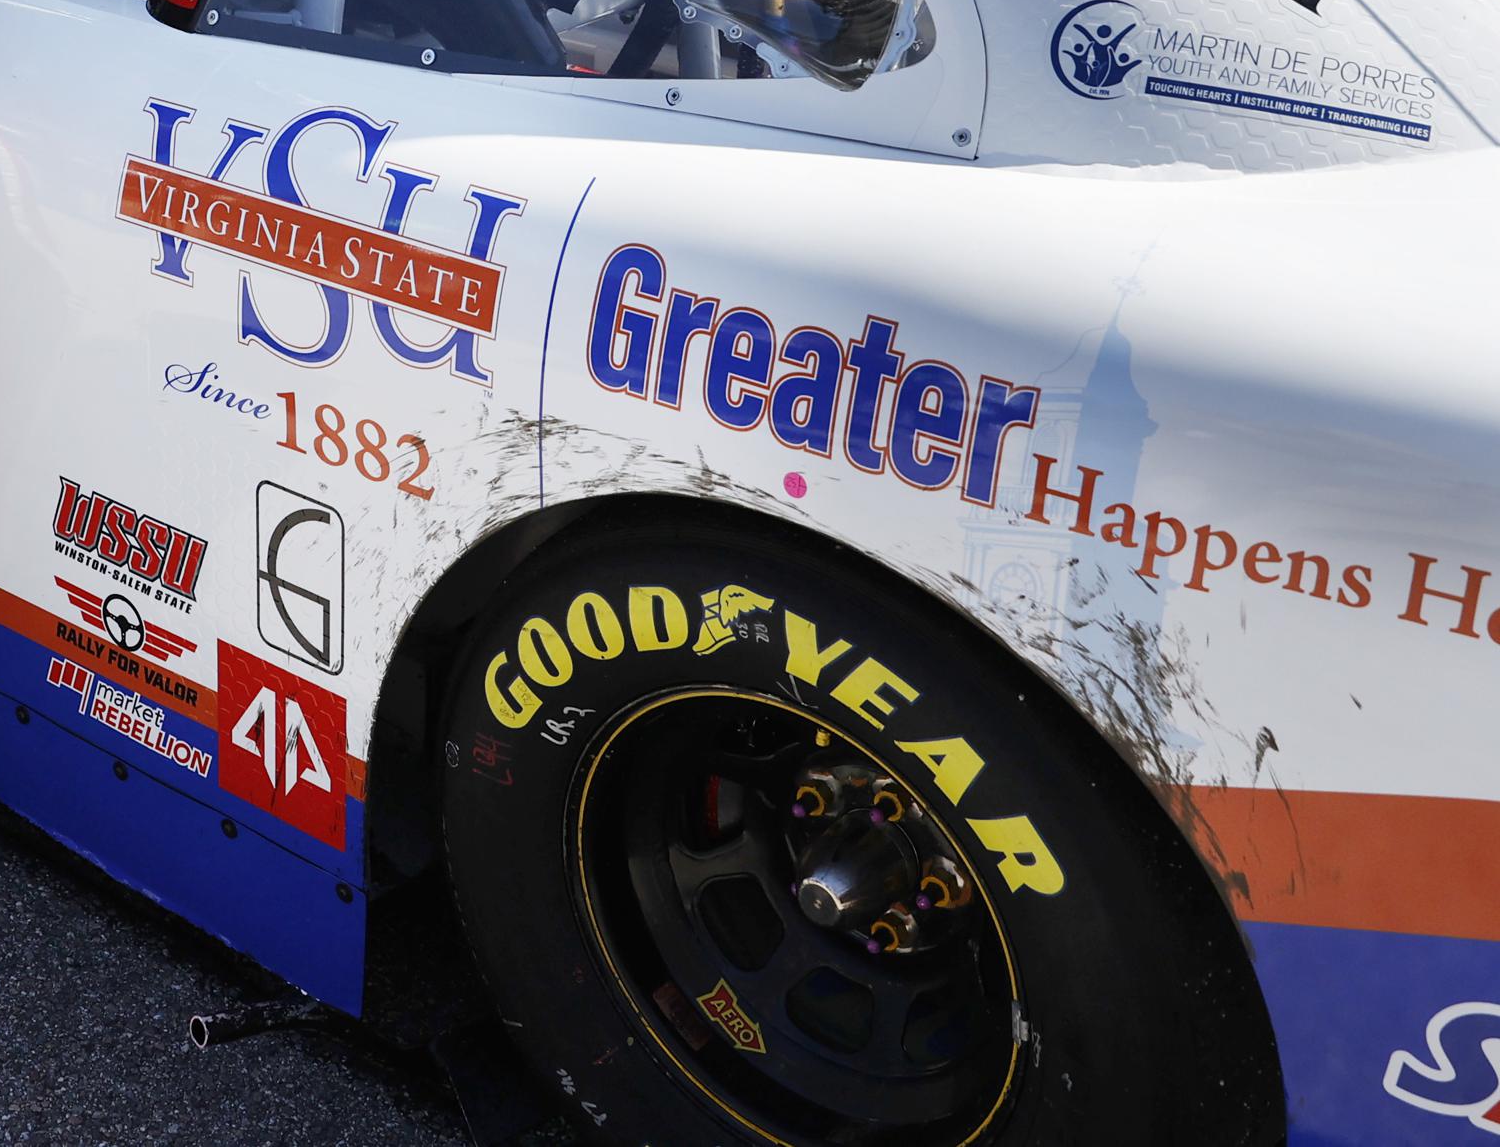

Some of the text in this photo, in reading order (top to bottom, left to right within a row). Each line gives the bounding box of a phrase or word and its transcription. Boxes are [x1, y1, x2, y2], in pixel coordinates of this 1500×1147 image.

[1148, 54, 1433, 119] YOUTH AND FAMILY SERVICES
[1152, 27, 1437, 100] MARTIN DE PORRES
[1149, 81, 1430, 139] TOUCHING HEARTS INSTILLING HOPE TRANSFORMING LIVES
[135, 171, 483, 318] VIRGINIA STATE
[586, 242, 1042, 509] Greater
[163, 361, 436, 502] Since 1882
[53, 476, 209, 602] WSSU
[55, 541, 193, 615] WINSTON-SALEM STATE
[1024, 453, 1500, 645] Happens H
[56, 621, 198, 707] RALLY FOR VALOR
[91, 698, 213, 778] REBELLION
[97, 682, 165, 728] market
[710, 999, 754, 1044] AERO
